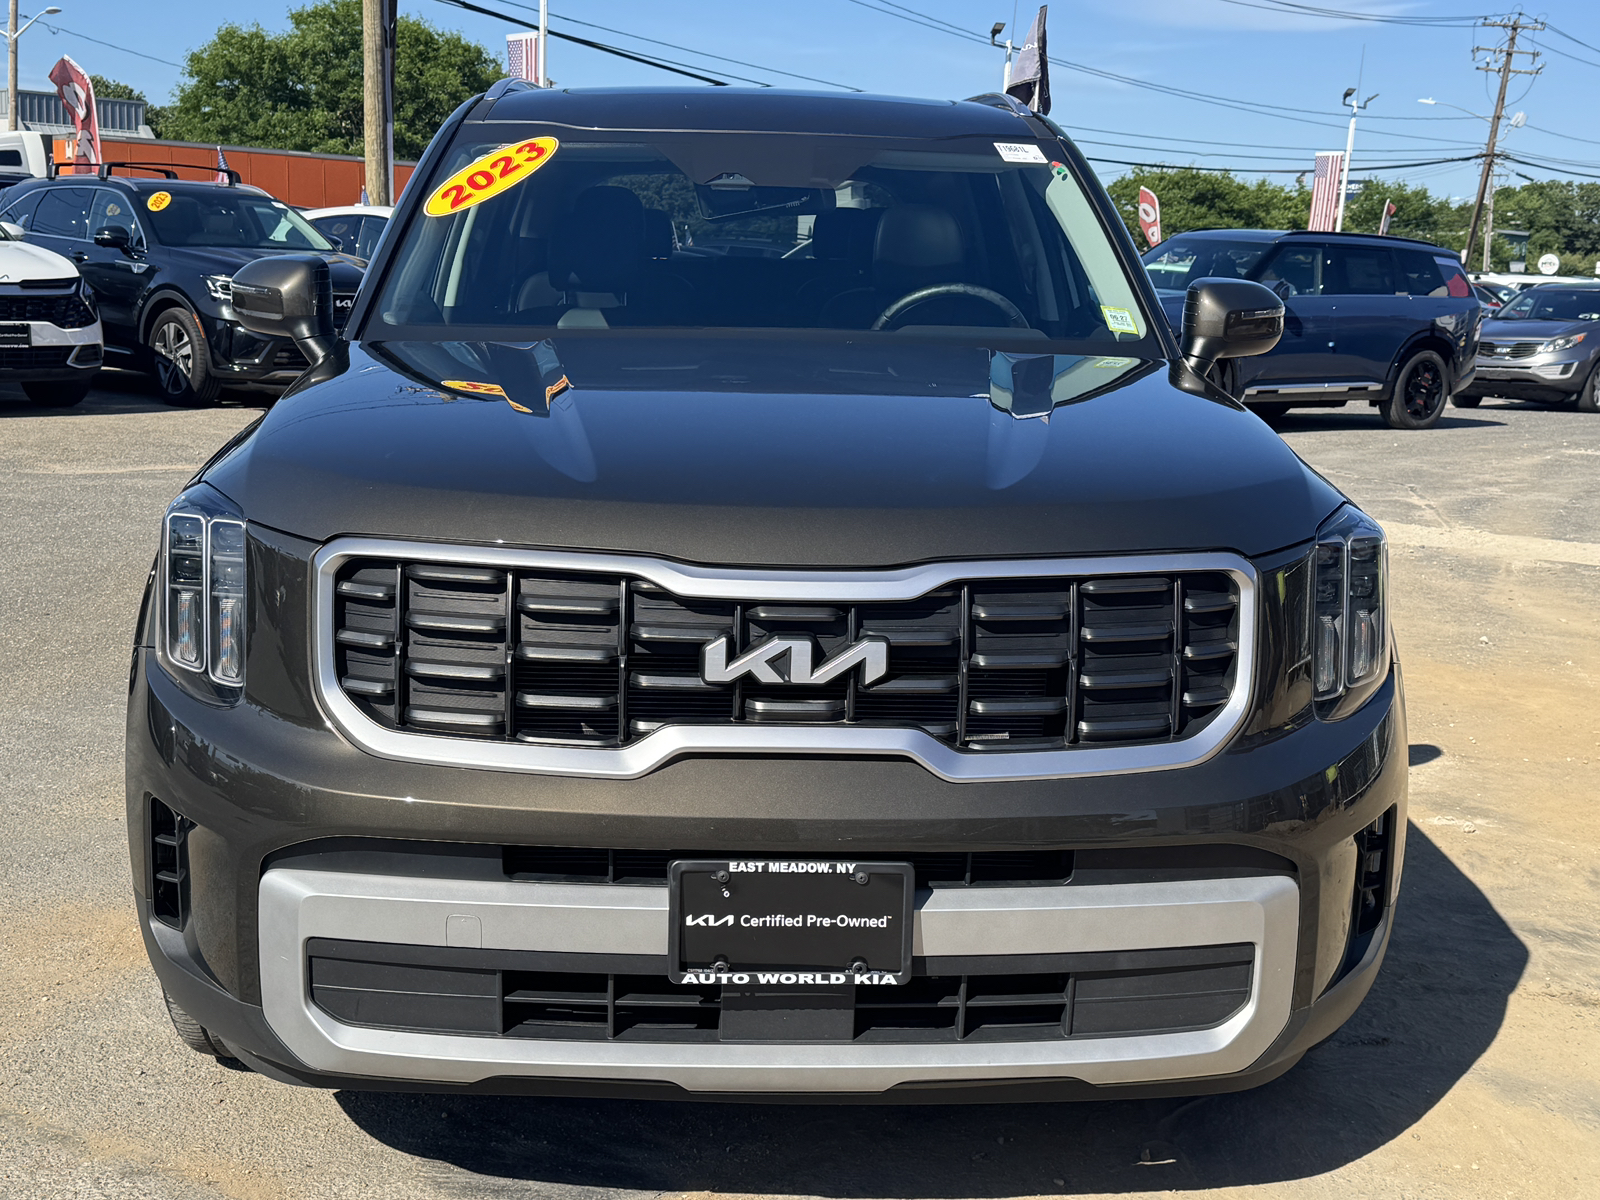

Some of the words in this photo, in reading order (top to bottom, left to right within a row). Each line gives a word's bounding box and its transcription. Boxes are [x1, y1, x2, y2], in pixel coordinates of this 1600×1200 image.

[441, 142, 547, 209] 2023
[151, 193, 169, 209] 2023
[703, 636, 888, 686] KIA
[729, 862, 765, 873] EAST
[836, 864, 857, 874] NY
[685, 914, 735, 927] KIA
[740, 914, 803, 927] Certified
[681, 973, 750, 985] AUTO
[757, 973, 846, 985] WORLD
[854, 973, 898, 985] KIA
